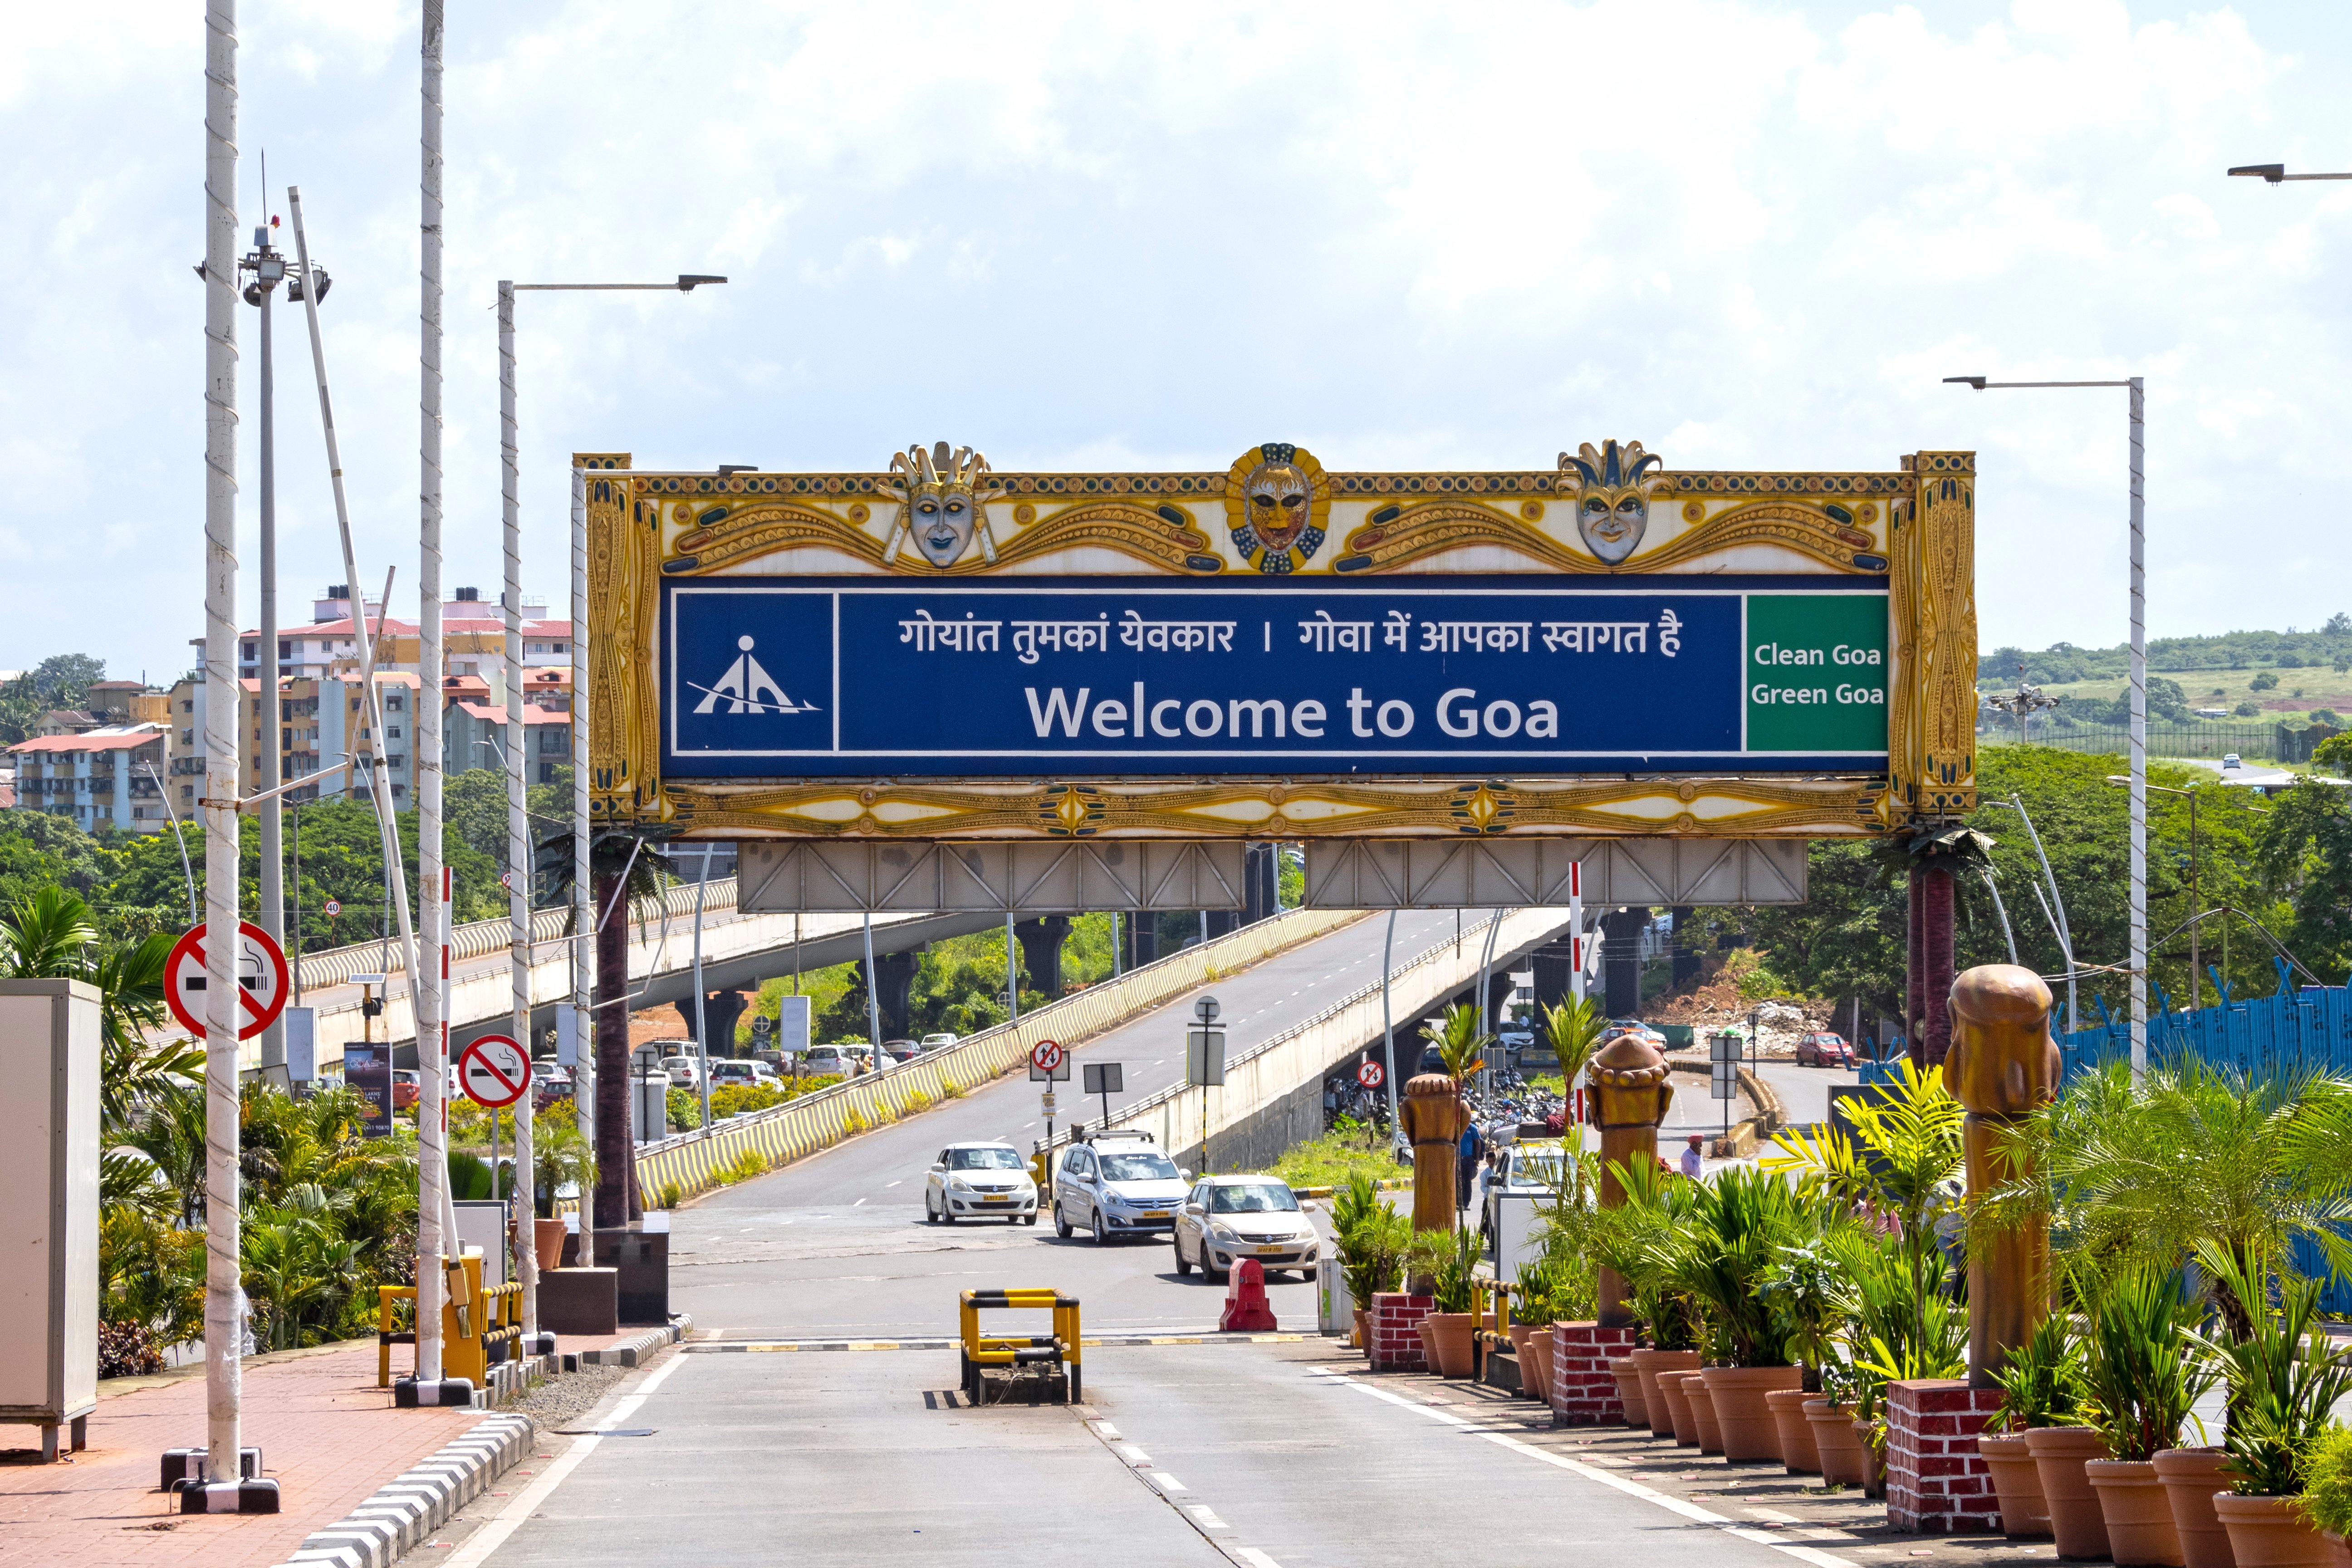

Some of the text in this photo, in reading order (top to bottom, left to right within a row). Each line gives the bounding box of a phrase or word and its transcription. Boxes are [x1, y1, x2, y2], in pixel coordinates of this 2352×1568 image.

[899, 609, 1002, 652] गोयांत
[1011, 612, 1110, 664] तुमकां
[1118, 610, 1237, 652] येवकार
[1298, 610, 1374, 652] गोवा
[1382, 610, 1411, 652] में
[1420, 622, 1532, 652] आपका
[1541, 622, 1649, 652] स्वागत
[1658, 609, 1682, 657] है
[1754, 642, 1881, 665] Clean Goa
[1025, 681, 1558, 737] Welcome to Goa
[1752, 683, 1883, 704] Green Goa
